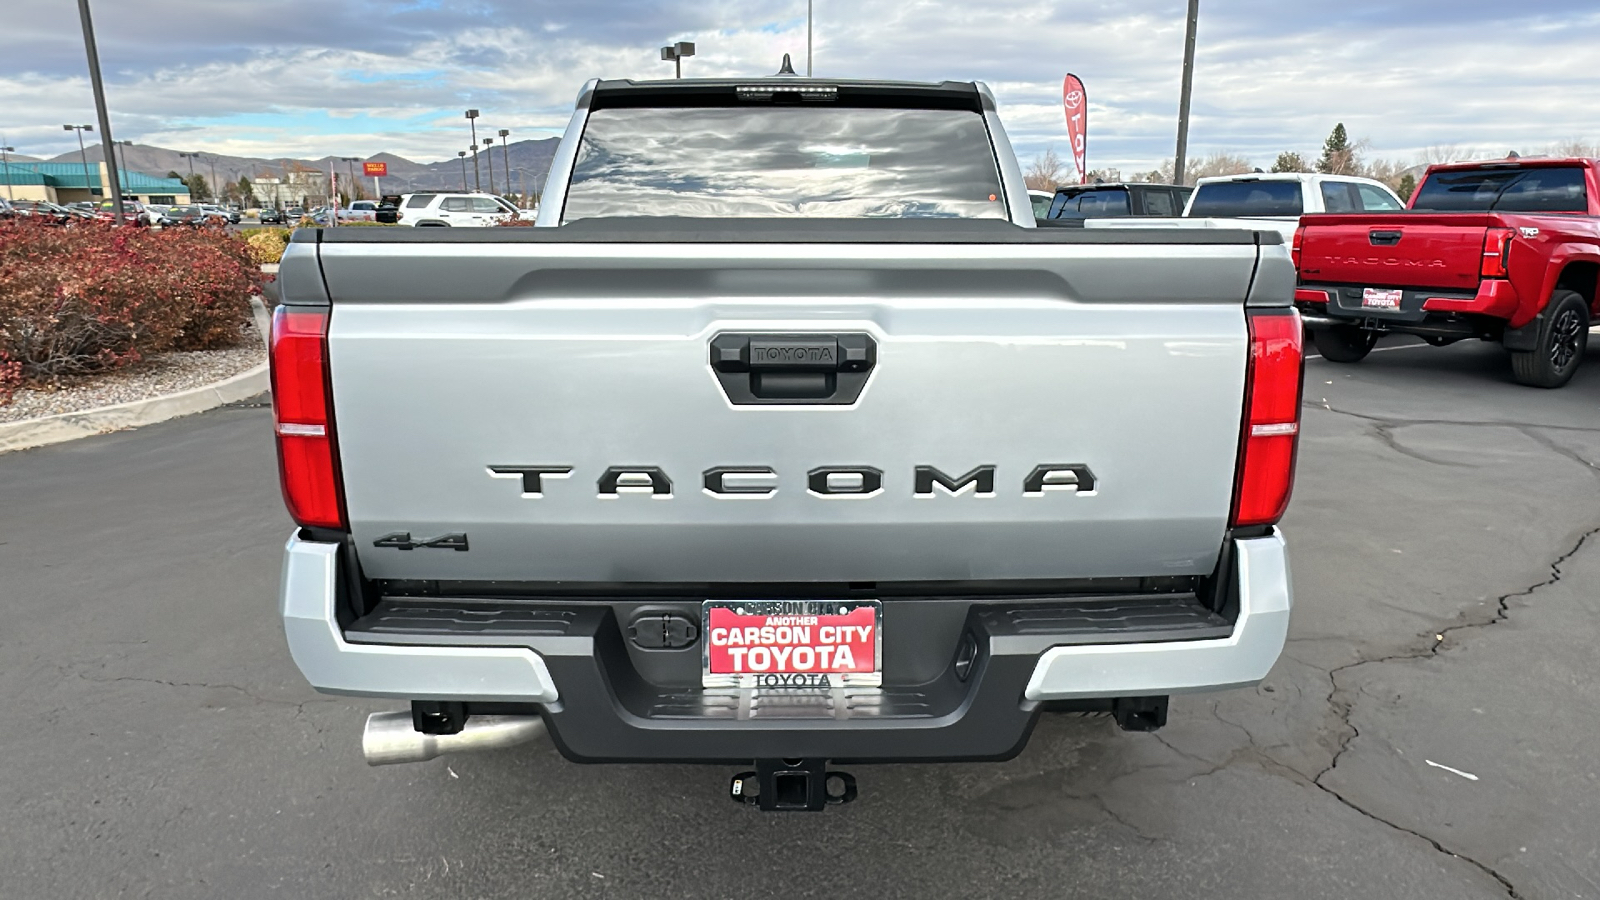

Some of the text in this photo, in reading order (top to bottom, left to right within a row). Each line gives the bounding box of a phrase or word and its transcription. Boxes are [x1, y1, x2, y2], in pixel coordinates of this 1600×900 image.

[1519, 226, 1539, 236] TRD
[1324, 256, 1447, 268] TACOMA
[754, 347, 833, 361] TOYOTA
[486, 463, 1099, 499] TACOMA
[765, 616, 818, 626] ANOTHER
[711, 625, 873, 646] CARSON CITY
[727, 644, 856, 672] TOYOTA
[753, 674, 831, 687] TOYOTA
